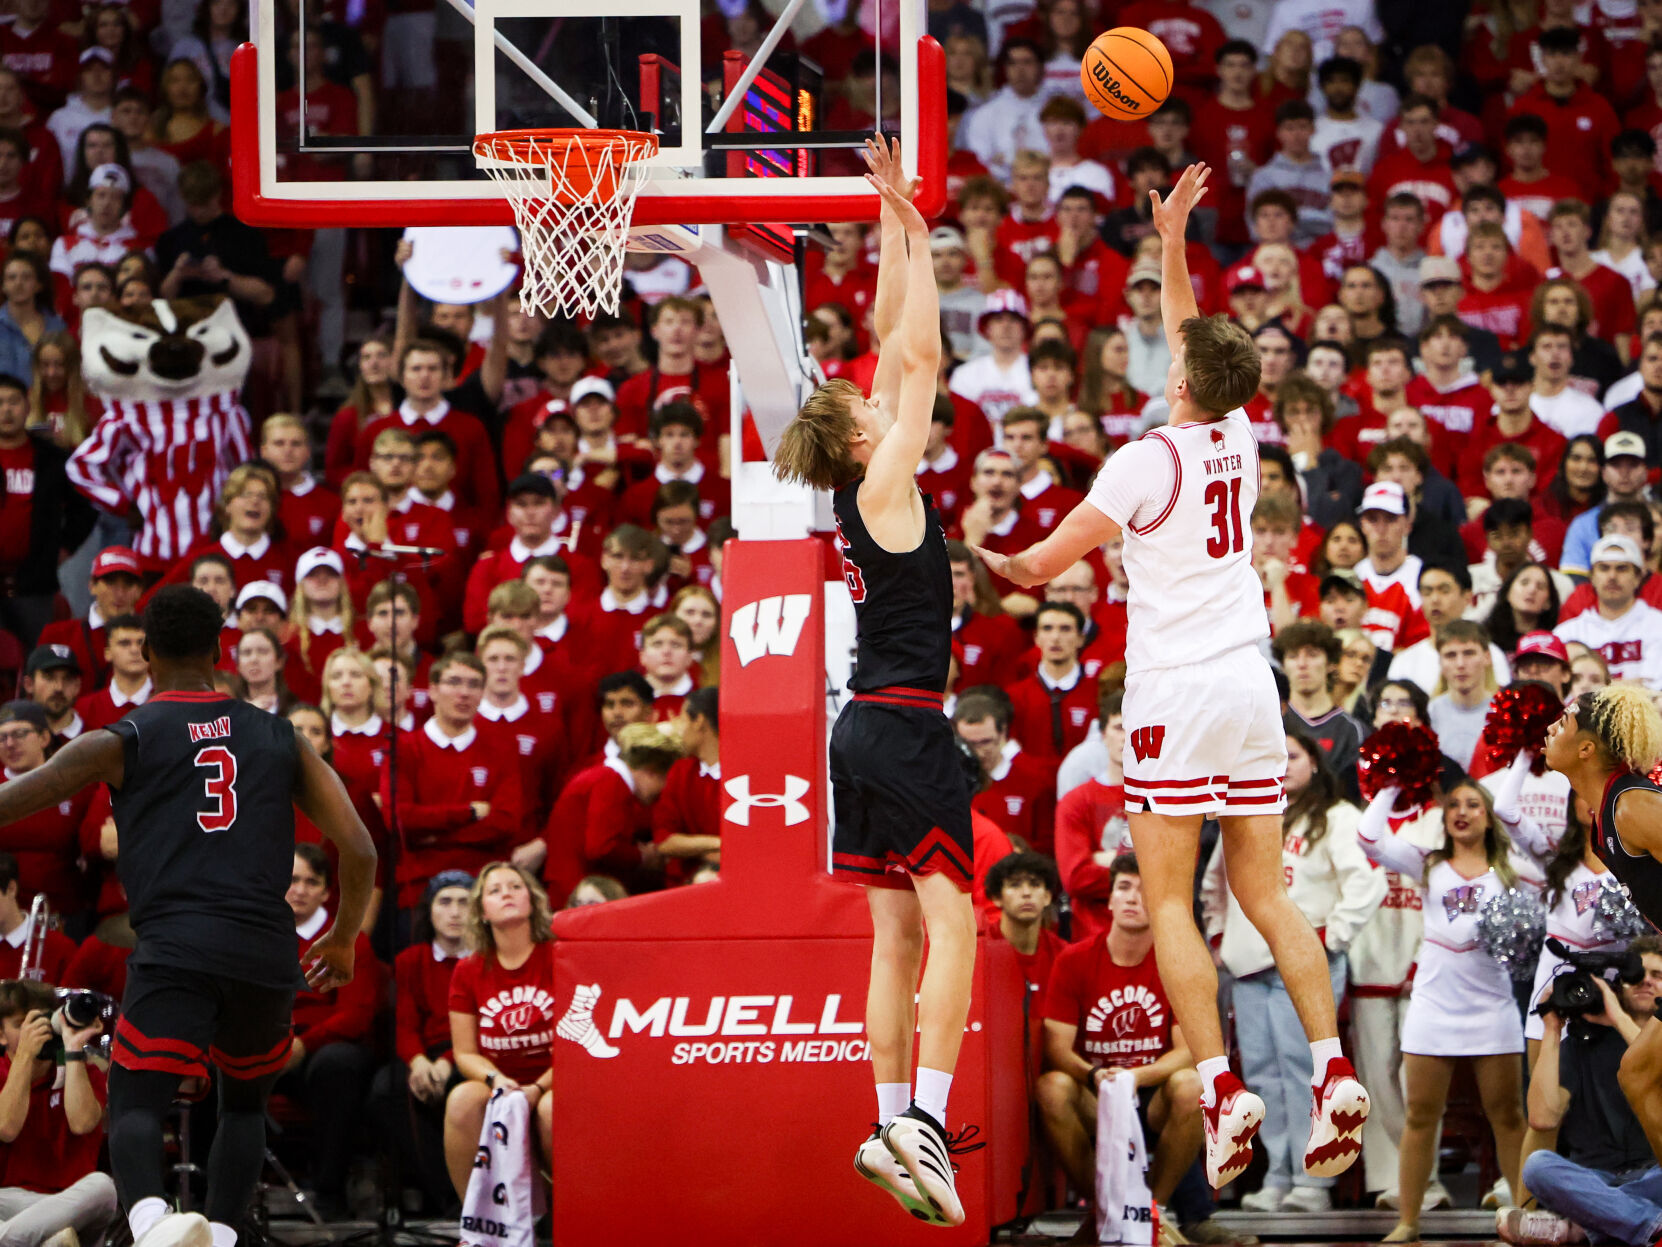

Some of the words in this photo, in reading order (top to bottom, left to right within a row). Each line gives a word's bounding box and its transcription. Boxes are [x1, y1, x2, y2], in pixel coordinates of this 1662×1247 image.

[1092, 60, 1140, 110] Wilson
[1203, 454, 1242, 475] WINTER
[1204, 477, 1244, 559] 31
[729, 593, 812, 669] W
[187, 716, 231, 743] KELLY
[1130, 724, 1166, 765] W
[193, 746, 237, 832] 3
[1516, 792, 1567, 807] SCONSIN
[608, 994, 968, 1038] MUELL
[1085, 985, 1164, 1033] WISCONSIN
[671, 1041, 776, 1065] SPORTS
[780, 1040, 874, 1062] MEDICI
[1085, 1036, 1163, 1055] BASKETBALL
